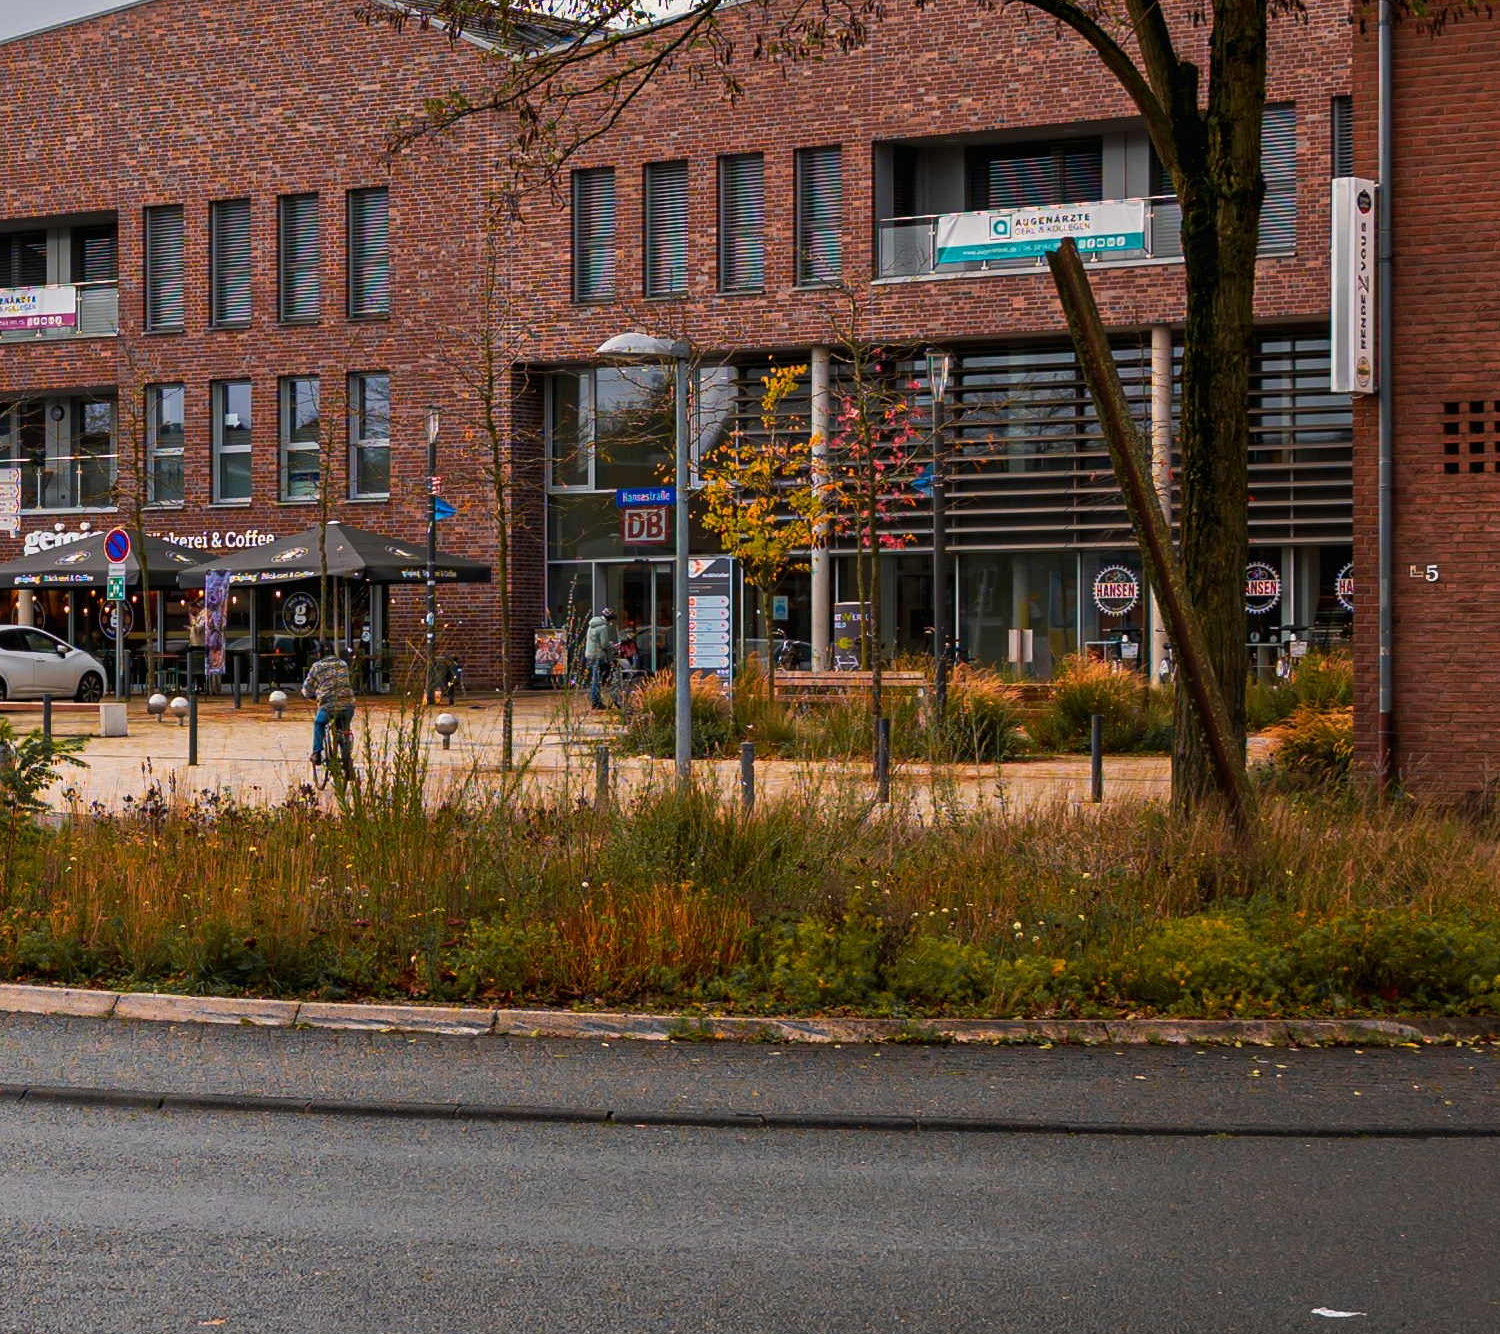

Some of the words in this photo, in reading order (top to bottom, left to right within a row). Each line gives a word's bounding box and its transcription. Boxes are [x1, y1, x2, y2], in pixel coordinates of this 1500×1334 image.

[628, 512, 663, 538] DB
[211, 532, 222, 548] &
[225, 530, 275, 548] Coffee
[1096, 583, 1135, 598] HANSEN
[1246, 580, 1277, 596] ANSEN
